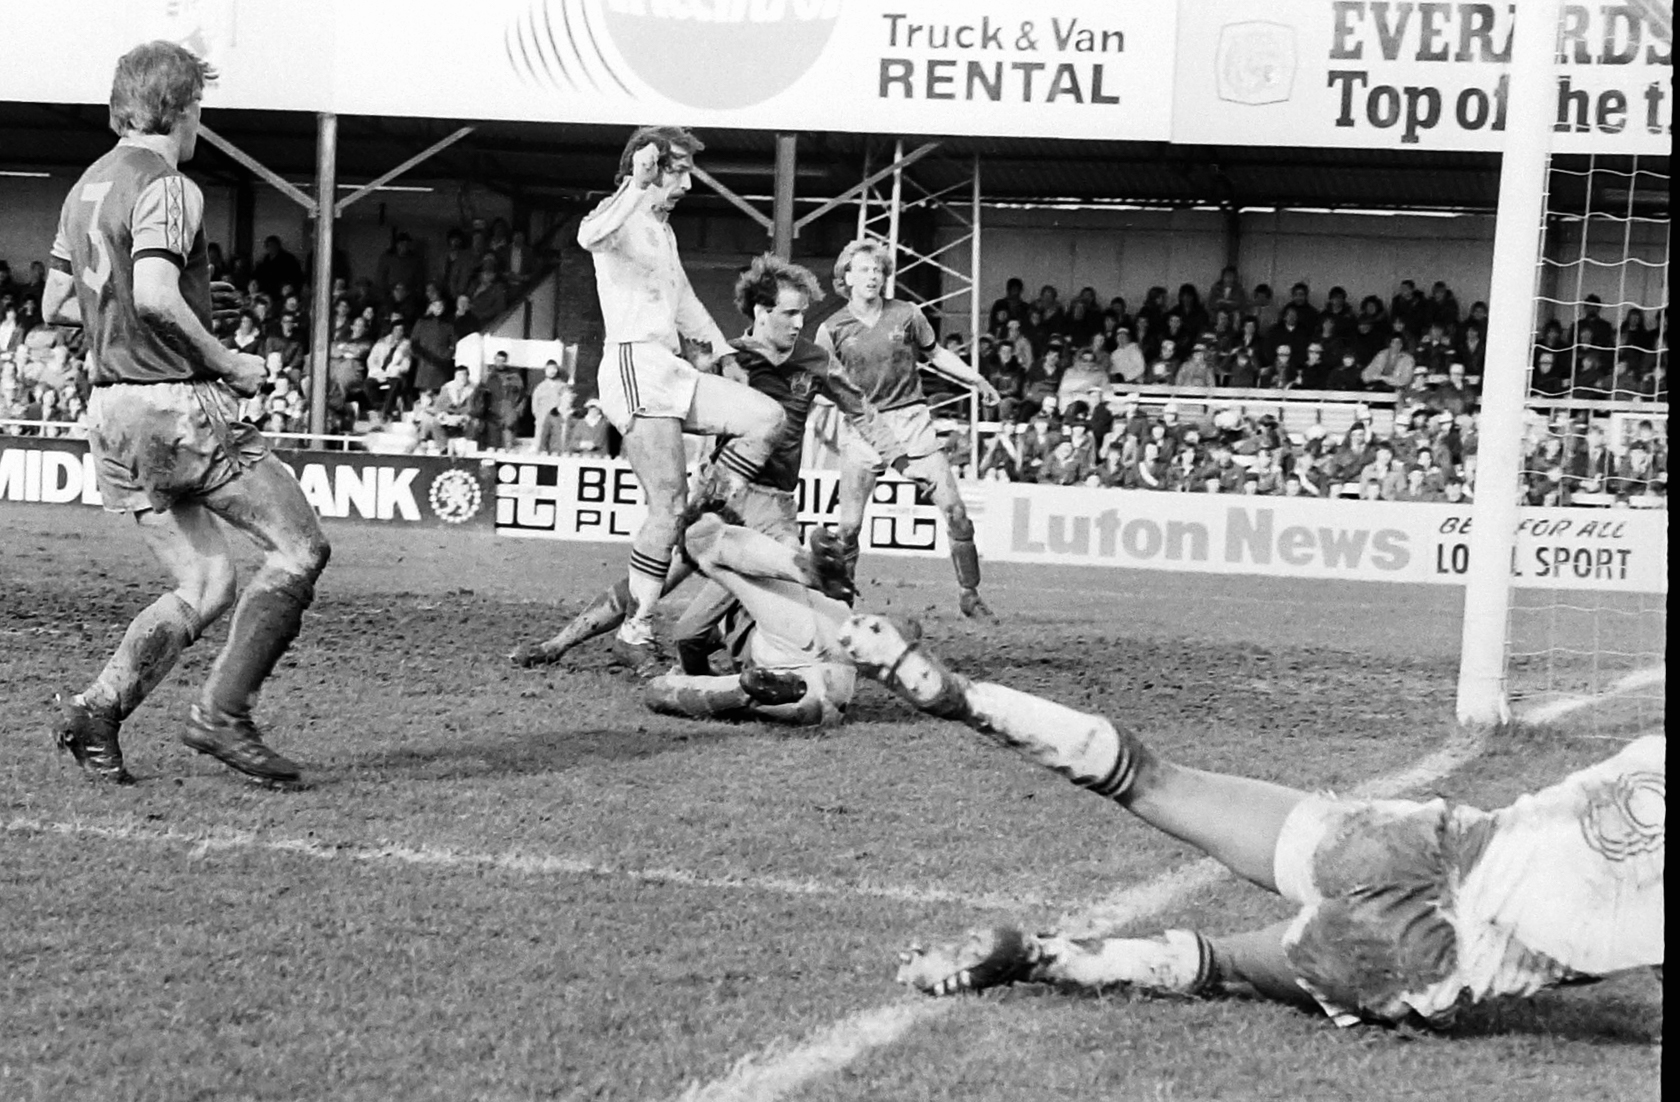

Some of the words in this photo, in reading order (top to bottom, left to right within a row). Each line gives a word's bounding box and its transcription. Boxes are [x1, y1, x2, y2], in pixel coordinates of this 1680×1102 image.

[883, 14, 1003, 51] Truck
[1015, 21, 1037, 51] &
[1052, 18, 1125, 52] Van
[878, 58, 1121, 104] RENTAL
[1328, 70, 1442, 144] Top
[1552, 75, 1627, 134] he
[284, 462, 422, 521] ANK
[1011, 498, 1209, 562] Luton
[1224, 507, 1412, 571] News
[1439, 517, 1473, 534] BE
[1514, 519, 1573, 537] FOR
[1576, 521, 1627, 538] ALL
[1437, 543, 1523, 577] LOL
[1535, 546, 1632, 579] SPORT
